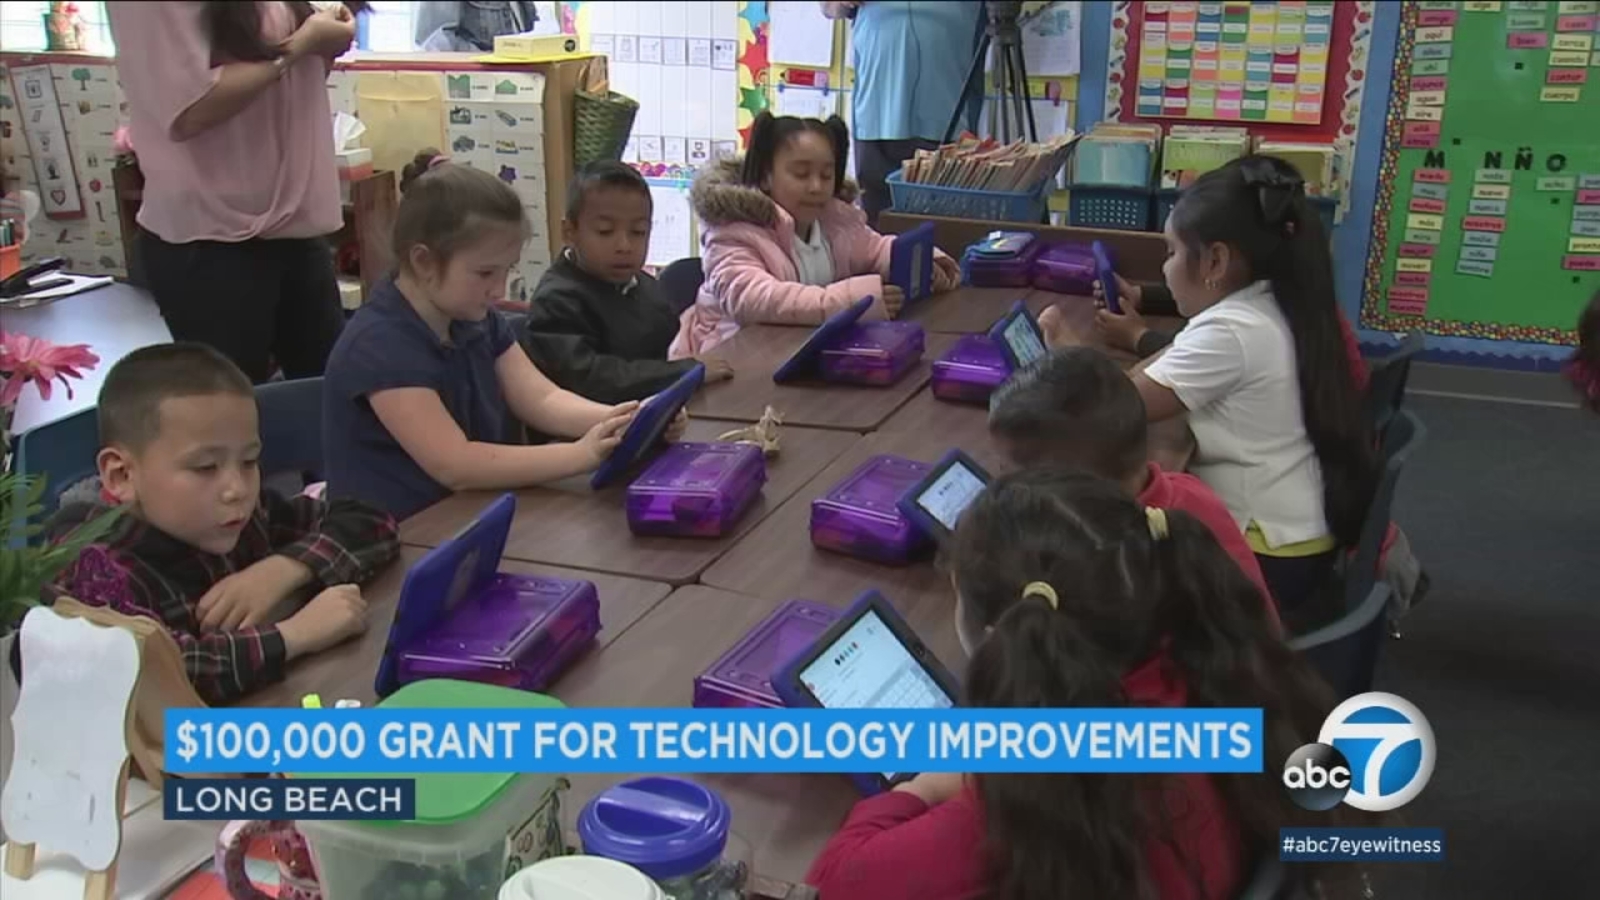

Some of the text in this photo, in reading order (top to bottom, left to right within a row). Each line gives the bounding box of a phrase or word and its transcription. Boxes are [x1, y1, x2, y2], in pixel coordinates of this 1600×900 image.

[1423, 150, 1446, 169] M
[1484, 151, 1503, 169] N
[1546, 153, 1567, 172] O
